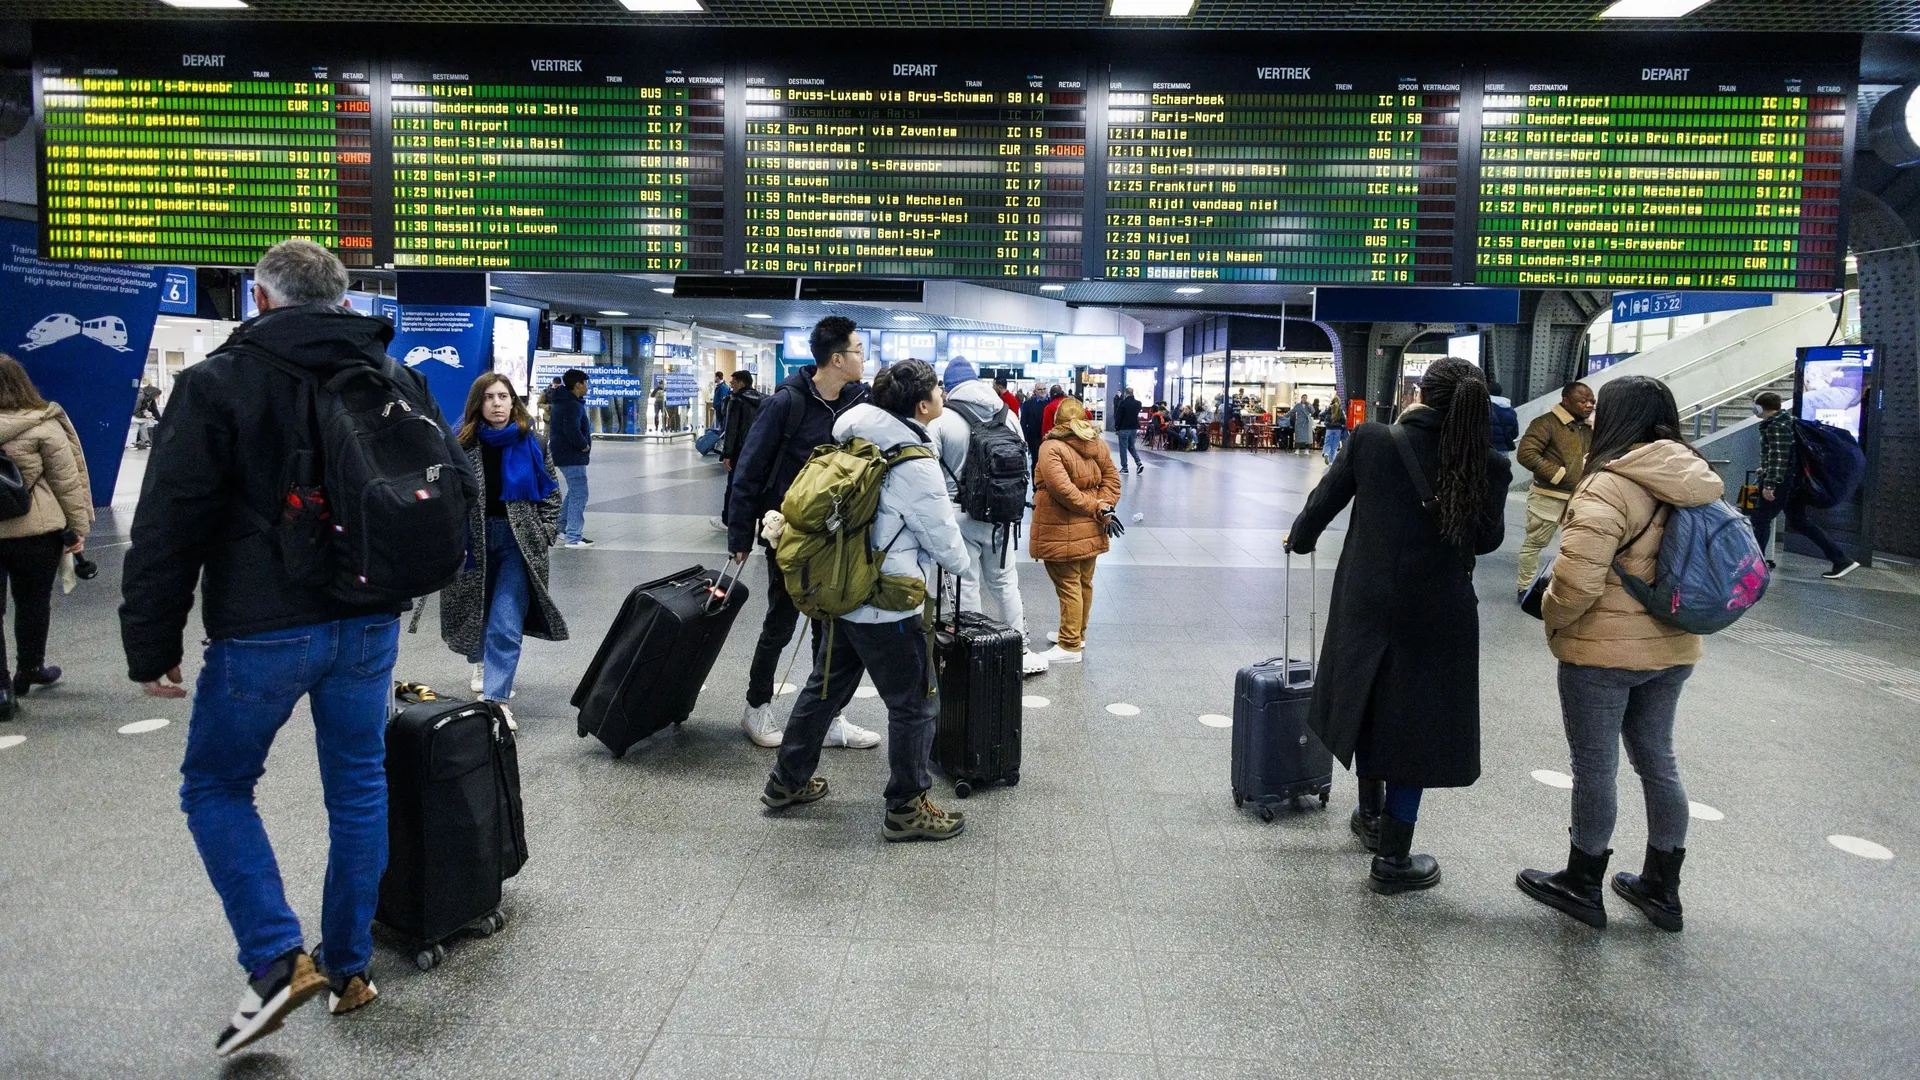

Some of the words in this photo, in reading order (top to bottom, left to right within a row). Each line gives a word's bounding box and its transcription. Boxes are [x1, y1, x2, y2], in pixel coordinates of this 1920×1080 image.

[182, 55, 226, 66] DEPART
[531, 60, 582, 72] VERTREK
[893, 64, 937, 76] DEPART
[1257, 68, 1310, 79] VERTREK
[1642, 68, 1690, 80] DEPART
[789, 90, 872, 101] Bruss-Luxemb
[880, 91, 900, 101] via
[908, 92, 993, 103] Brus-Schuman
[1030, 93, 1043, 103] 14
[1153, 94, 1224, 105] Schaarbeek
[1379, 96, 1393, 106] IC
[1402, 96, 1415, 106] 16
[84, 97, 158, 108] Londen-St-P
[288, 100, 308, 111] EUR
[322, 101, 328, 111] 3
[85, 113, 138, 125] Check-in
[145, 114, 199, 126] gesloten
[1152, 112, 1224, 122] Paris-Nord
[1370, 113, 1392, 123] EUR
[393, 119, 425, 130] 11:21
[433, 120, 454, 130] Bru
[461, 121, 508, 131] Airport
[648, 122, 661, 133] IC
[669, 123, 681, 133] 17
[747, 124, 780, 134] 11:52
[788, 124, 808, 134] Bru
[816, 125, 864, 136] Airport
[873, 126, 893, 136] via
[901, 126, 957, 136] Zaventem
[1007, 127, 1021, 138] IC
[1030, 127, 1042, 138] 15
[1109, 129, 1144, 139] 12:14
[1151, 129, 1187, 140] Halle
[1377, 131, 1392, 141] IC
[1400, 131, 1414, 141] 17
[1483, 131, 1518, 142] 12:42
[1526, 132, 1593, 142] Rotterdam
[1601, 132, 1608, 142] C
[1616, 133, 1638, 143] via
[1646, 133, 1668, 143] Bru
[1677, 133, 1729, 145] Airport
[1760, 134, 1775, 144] EC
[1783, 134, 1797, 144] 11
[393, 136, 426, 147] 11:23
[434, 136, 495, 147] Gent-St-P
[502, 138, 523, 147] via
[530, 138, 564, 149] Aalst
[648, 140, 661, 150] IC
[669, 140, 682, 150] 13
[747, 141, 780, 151] 11:53
[788, 142, 851, 152] Amsterdam
[858, 142, 865, 152] C
[1000, 145, 1020, 155] EUR
[1035, 145, 1048, 155] 5A
[47, 180, 80, 192] 11:03
[87, 181, 140, 192] Oostende
[147, 182, 167, 192] via
[174, 182, 235, 194] Gent-St-P
[297, 185, 310, 195] IC
[318, 186, 330, 196] 11
[394, 187, 427, 197] 11:29
[434, 188, 474, 199] Nijvel
[641, 191, 661, 200] BUS
[1108, 181, 1142, 191] 12:25
[1150, 181, 1213, 192] Frankfurt
[1222, 182, 1236, 192] Hb
[1368, 184, 1389, 194] ICE
[1480, 184, 1516, 195] 12:49
[1524, 185, 1605, 196] Antwerpen-C
[1613, 186, 1635, 196] via
[1644, 186, 1703, 197] Mechelen
[1756, 187, 1770, 197] S1
[1779, 187, 1793, 197] 21
[746, 192, 780, 202] 11:59
[788, 193, 870, 203] Antw-Berchem
[878, 194, 899, 204] via
[906, 195, 962, 205] Mechelen
[1005, 196, 1019, 206] IC
[1027, 196, 1040, 206] 20
[1150, 199, 1184, 210] Rijdt
[1192, 200, 1243, 211] vandaag
[1250, 200, 1278, 210] niet
[49, 213, 81, 224] 11:09
[88, 214, 108, 225] Bru
[115, 215, 160, 227] Airport
[297, 219, 310, 229] IC
[318, 219, 331, 230] 12
[394, 221, 427, 231] 11:36
[434, 222, 481, 232] Hasselt
[489, 223, 509, 232] via
[517, 223, 557, 233] Leuven
[647, 225, 661, 235] IC
[669, 225, 681, 235] 12
[11, 244, 37, 255] Trains
[50, 247, 82, 258] 11:14
[89, 248, 122, 259] Halle
[1106, 250, 1140, 260] 12:30
[1148, 251, 1190, 261] Aarlen
[1198, 252, 1219, 261] via
[1226, 252, 1263, 262] Namen
[1372, 254, 1386, 263] IC
[1395, 254, 1408, 263] 17
[1476, 254, 1512, 265] 12:56
[1520, 255, 1601, 266] Londen-St-P
[1744, 258, 1766, 268] EUR
[1783, 258, 1788, 268] 1
[3, 263, 59, 277] Internationale
[24, 275, 44, 286] High
[73, 281, 118, 292] international
[120, 286, 139, 294] trains
[1519, 272, 1578, 283] Check-in
[1586, 275, 1600, 284] nu
[1609, 274, 1668, 284] voorzien
[1676, 276, 1690, 284] om
[1700, 275, 1736, 285] 11:45
[170, 284, 180, 300] 6
[1654, 301, 1660, 311] 3
[1669, 298, 1680, 309] 22
[590, 378, 640, 387] verbindingen
[593, 388, 641, 396] Reiseverkehr
[586, 398, 609, 406] traffic
